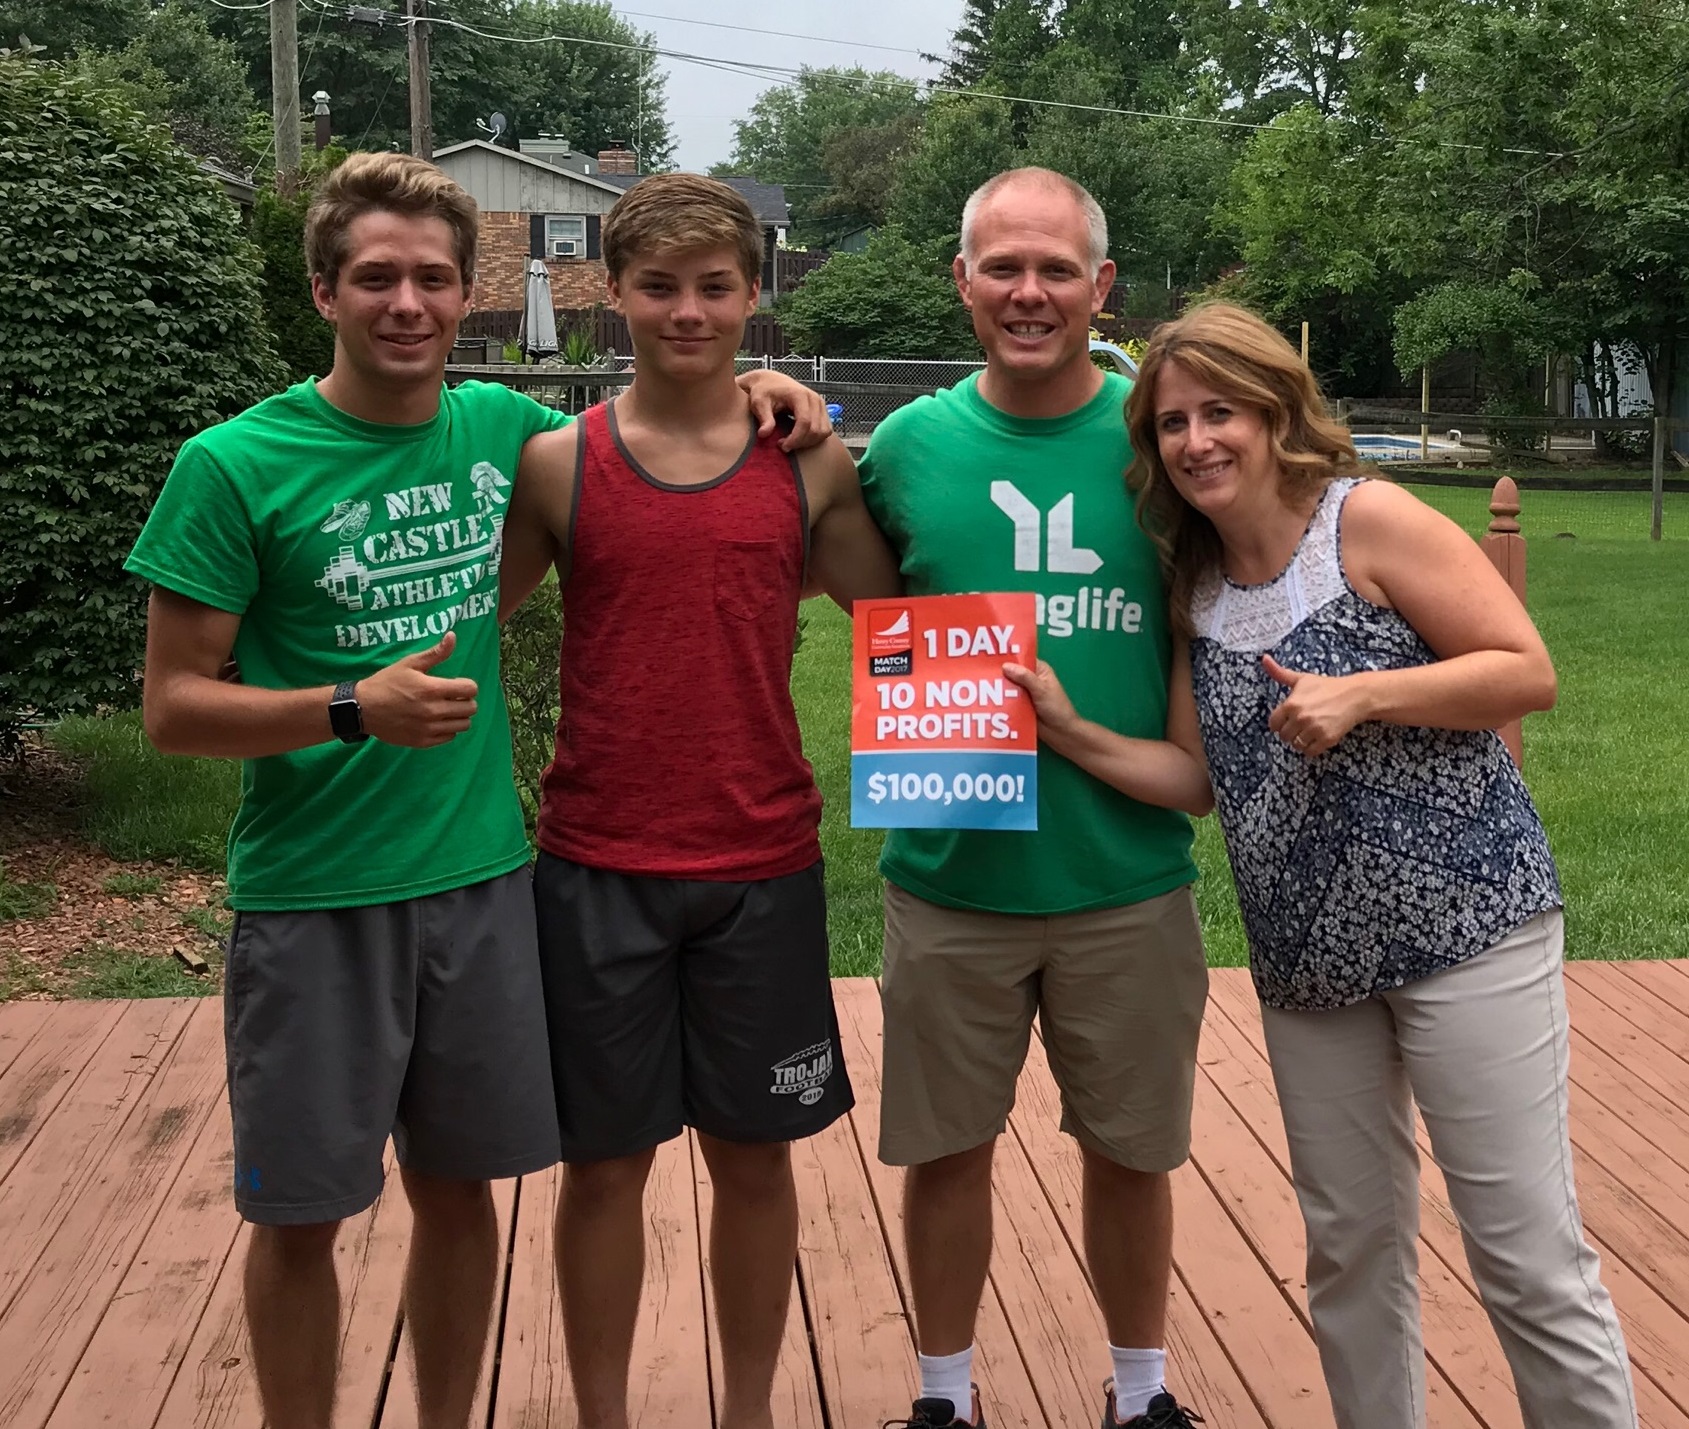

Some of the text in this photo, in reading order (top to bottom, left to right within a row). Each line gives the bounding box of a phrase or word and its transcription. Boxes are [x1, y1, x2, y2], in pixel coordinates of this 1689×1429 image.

[383, 482, 453, 521] NEW
[363, 513, 488, 564] CASTLE
[990, 480, 1104, 574] YL
[370, 563, 486, 611] ATHLETI
[923, 624, 1021, 658] 1 DAY.
[874, 657, 908, 666] MATCH
[876, 678, 1018, 710] 10 NON-
[876, 713, 1018, 741] PROFITS.
[867, 771, 1025, 805] $100,000!
